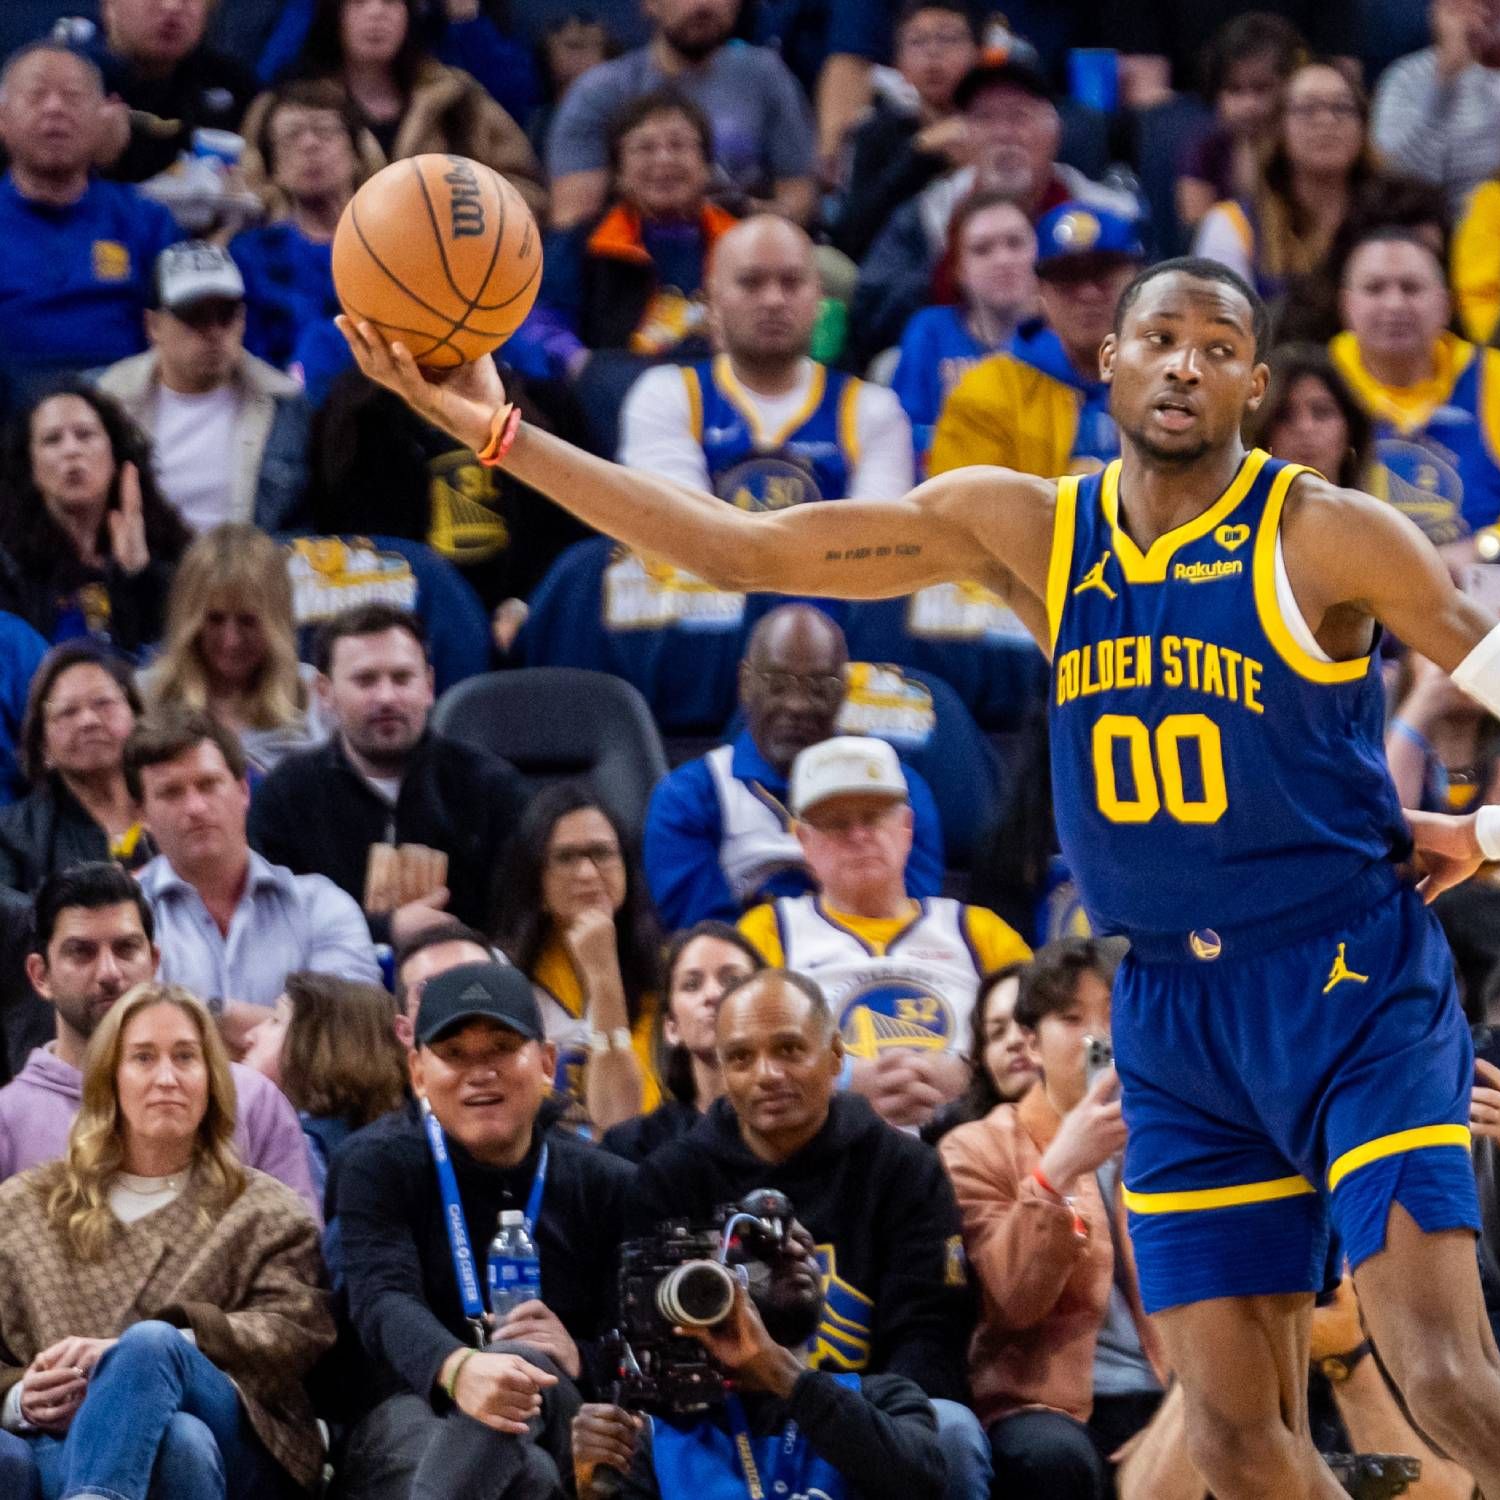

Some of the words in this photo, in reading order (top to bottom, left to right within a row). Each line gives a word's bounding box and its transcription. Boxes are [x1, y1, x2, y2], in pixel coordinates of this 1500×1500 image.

[1174, 559, 1243, 579] Rakuten
[1056, 635, 1152, 706] GOLDEN
[1161, 635, 1265, 714] STATE
[1091, 713, 1229, 824] 00
[448, 1202, 468, 1248] CHASE
[459, 1258, 479, 1301] CENTER
